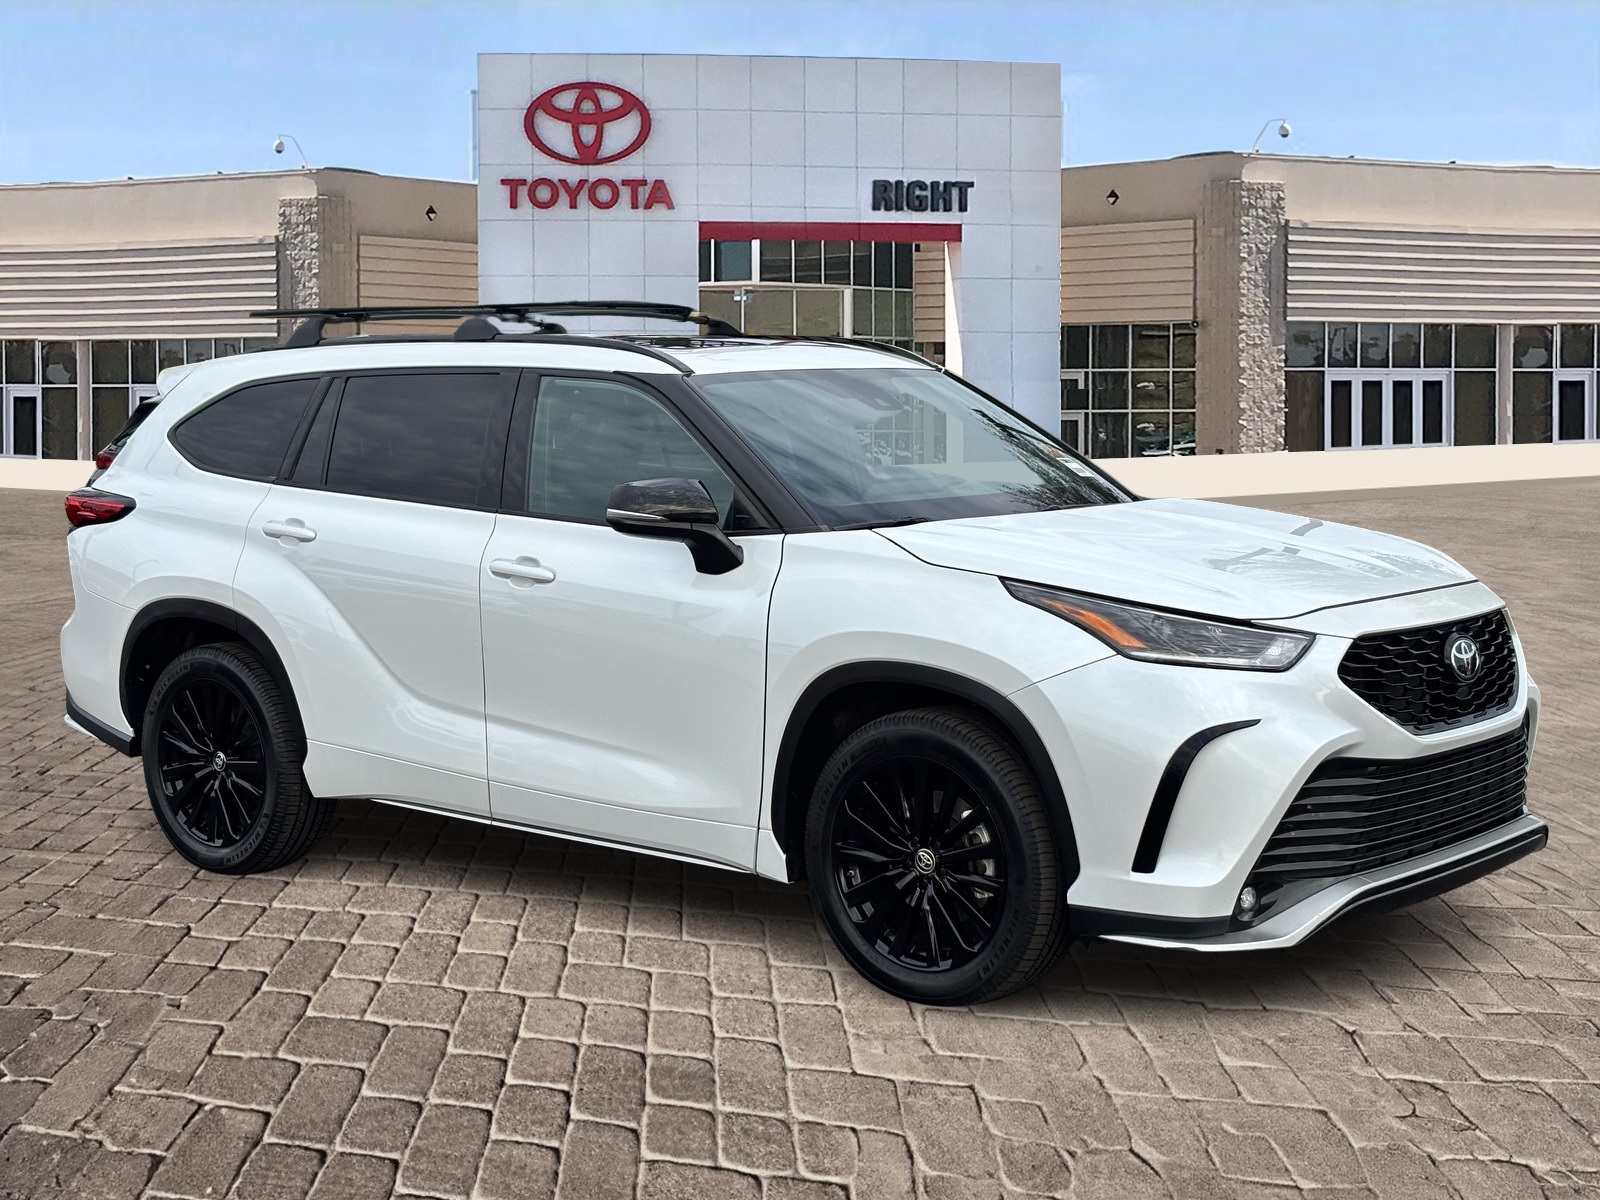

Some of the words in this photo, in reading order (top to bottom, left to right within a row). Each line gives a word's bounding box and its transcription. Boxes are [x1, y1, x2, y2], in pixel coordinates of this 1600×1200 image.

[500, 178, 675, 209] TOYOTA
[872, 180, 974, 212] RIGHT
[226, 830, 261, 863] MICHELIN
[982, 906, 1020, 975] MICHELIN
